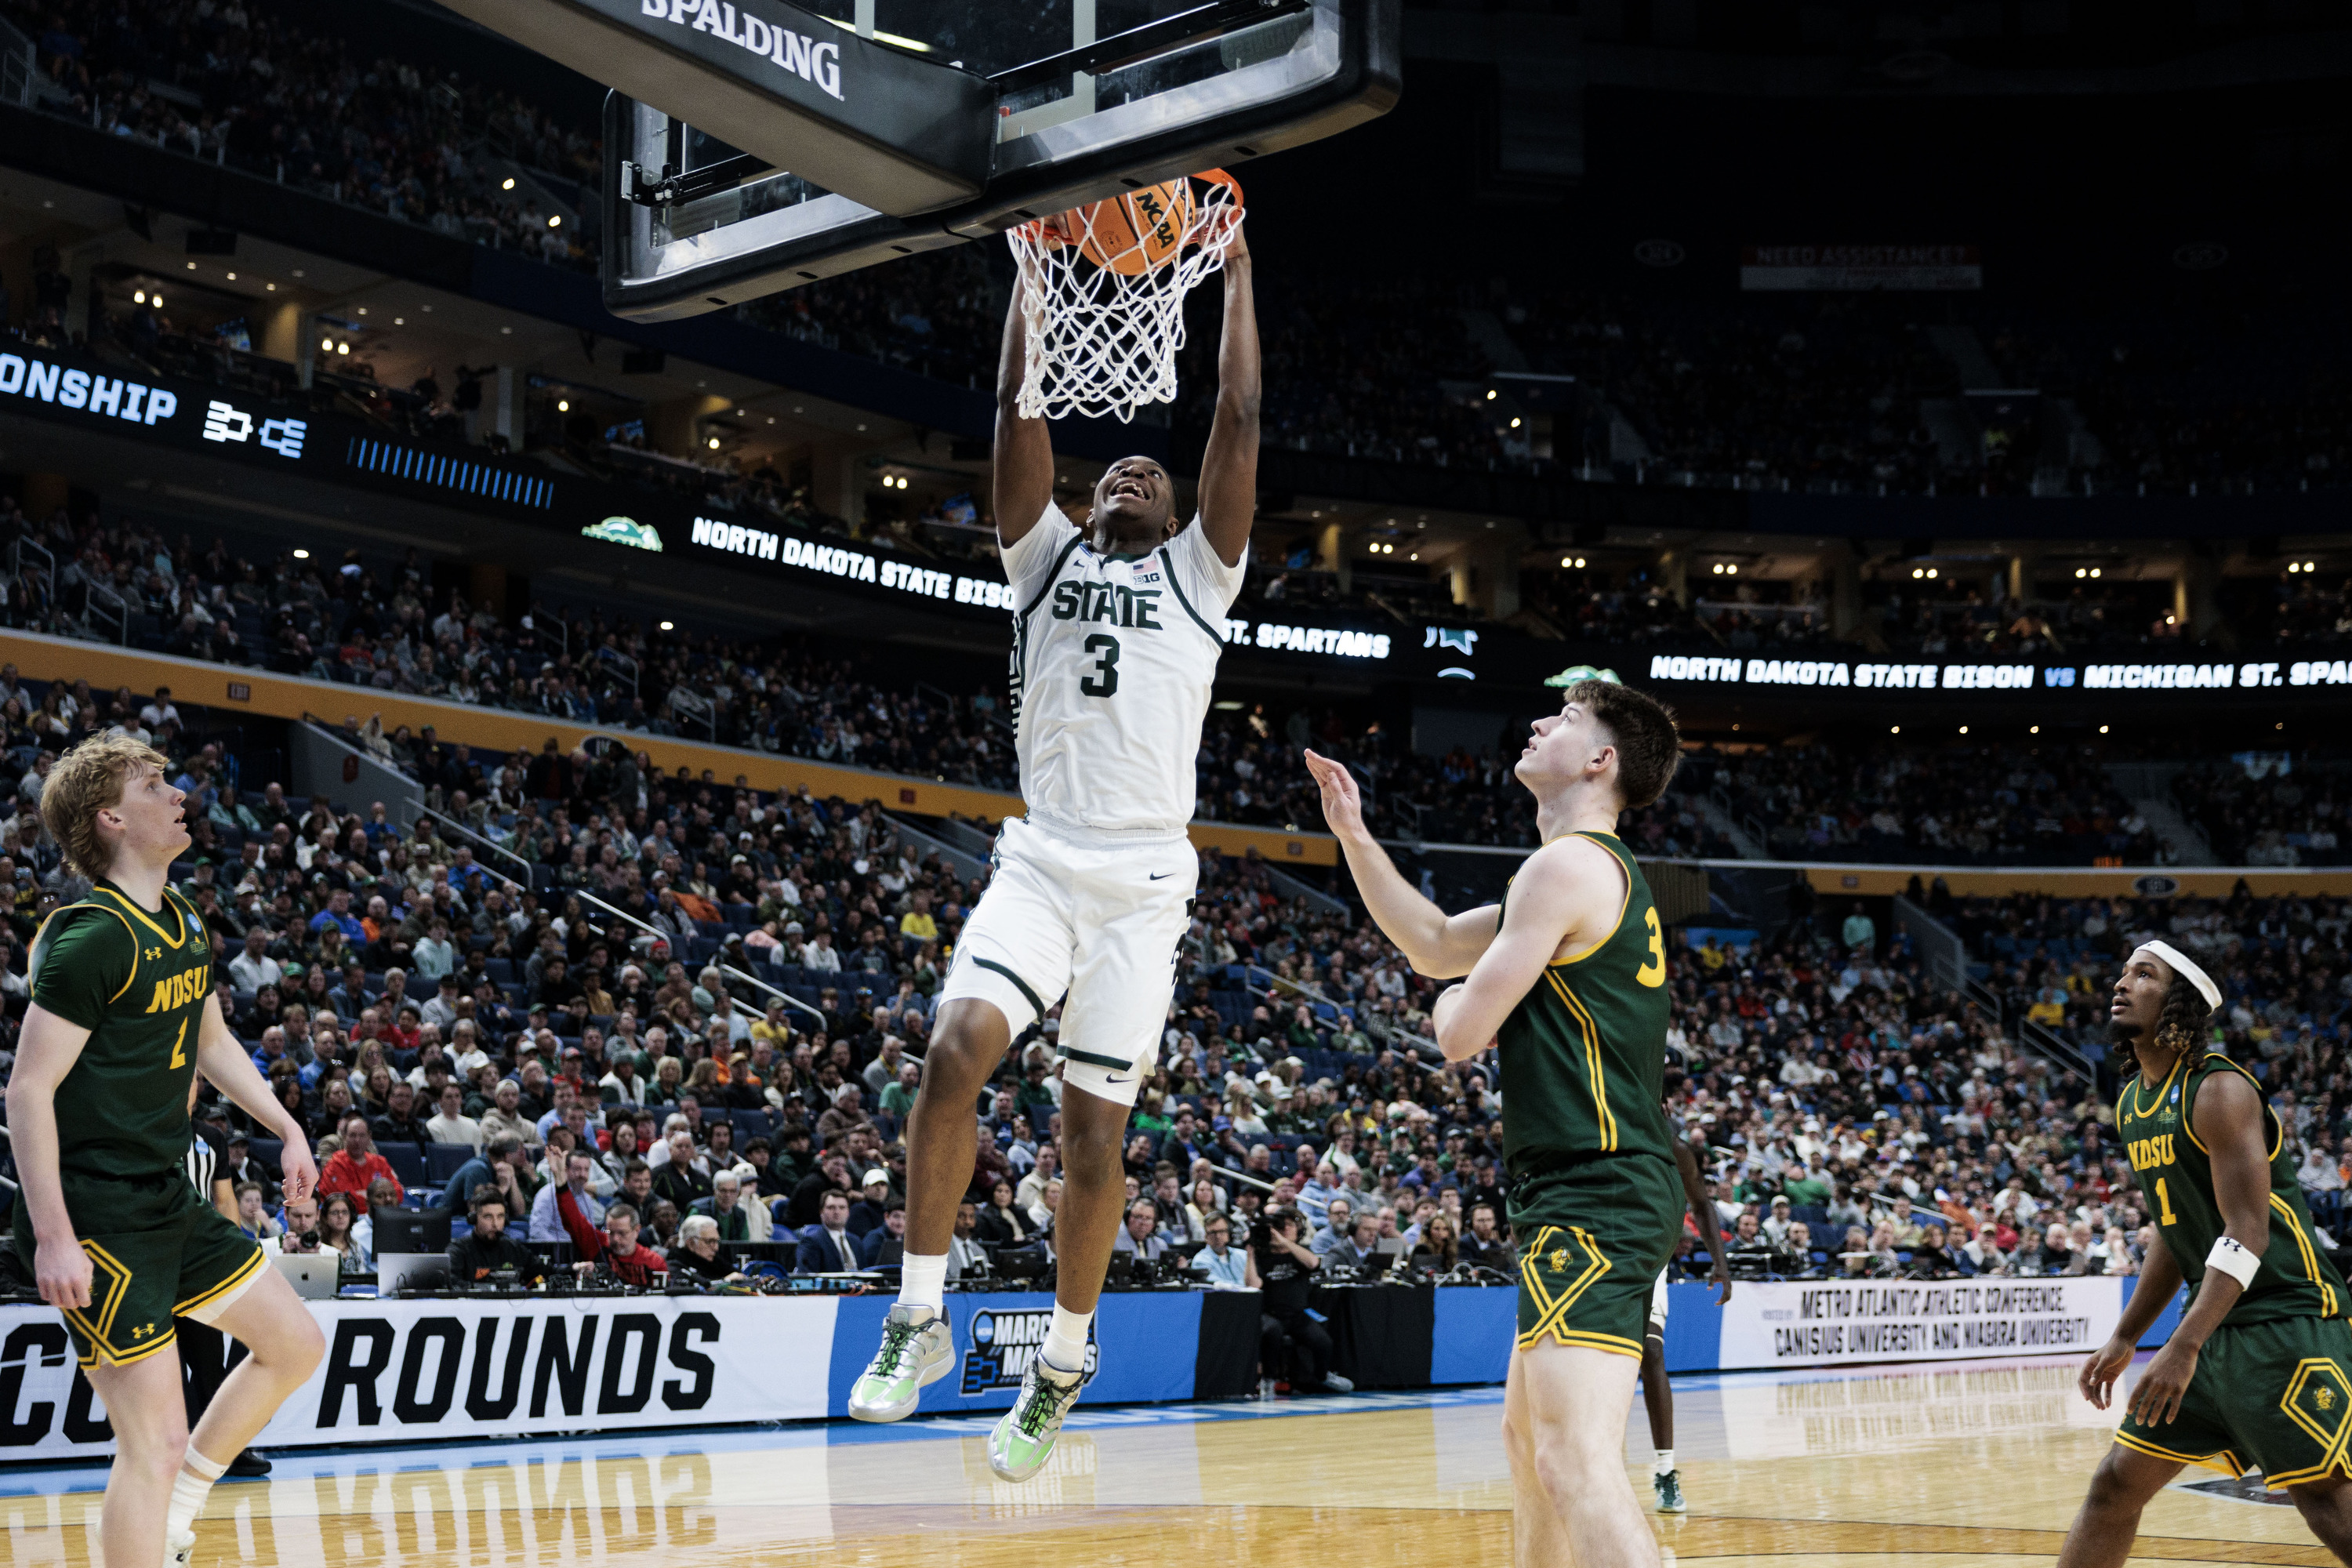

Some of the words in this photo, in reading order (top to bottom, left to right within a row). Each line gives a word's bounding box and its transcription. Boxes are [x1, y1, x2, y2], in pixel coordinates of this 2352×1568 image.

[1135, 191, 1174, 249] NCAA
[1757, 246, 1816, 265] NEED
[0, 353, 177, 426] ONSHIP
[691, 517, 779, 561] NORTH
[782, 537, 876, 583] DAKOTA
[880, 561, 953, 599] STATE
[954, 576, 1015, 611] BISO
[1051, 580, 1163, 630] STATE
[1256, 623, 1391, 659] SPARTANS
[1080, 633, 1120, 698] 3
[1650, 655, 1742, 682] NORTH
[1745, 659, 1850, 686] DAKOTA
[1853, 663, 1939, 688] STATE
[1942, 665, 2034, 688] BISON
[2044, 667, 2076, 687] VS
[2082, 664, 2234, 688] MICHIGAN
[2238, 662, 2283, 687] ST.
[2288, 661, 2352, 686] SPA
[1635, 906, 1666, 988] 3
[145, 965, 209, 1013] NDSU
[2127, 1134, 2176, 1172] NDSU
[2155, 1177, 2177, 1226] 1
[1800, 1290, 1851, 1319] METRO
[1856, 1289, 1918, 1316] ATLANTIC
[1921, 1287, 1980, 1316] ATHLETIC
[993, 1315, 1054, 1345] MARC
[1775, 1326, 1842, 1356] CANISIUS
[1849, 1323, 1927, 1352] UNIVERSITY
[1933, 1323, 1958, 1349] AND
[1962, 1320, 2016, 1348] NIAGARA
[2020, 1316, 2090, 1345] UNIVERSITY
[316, 1312, 720, 1428] ROUNDS
